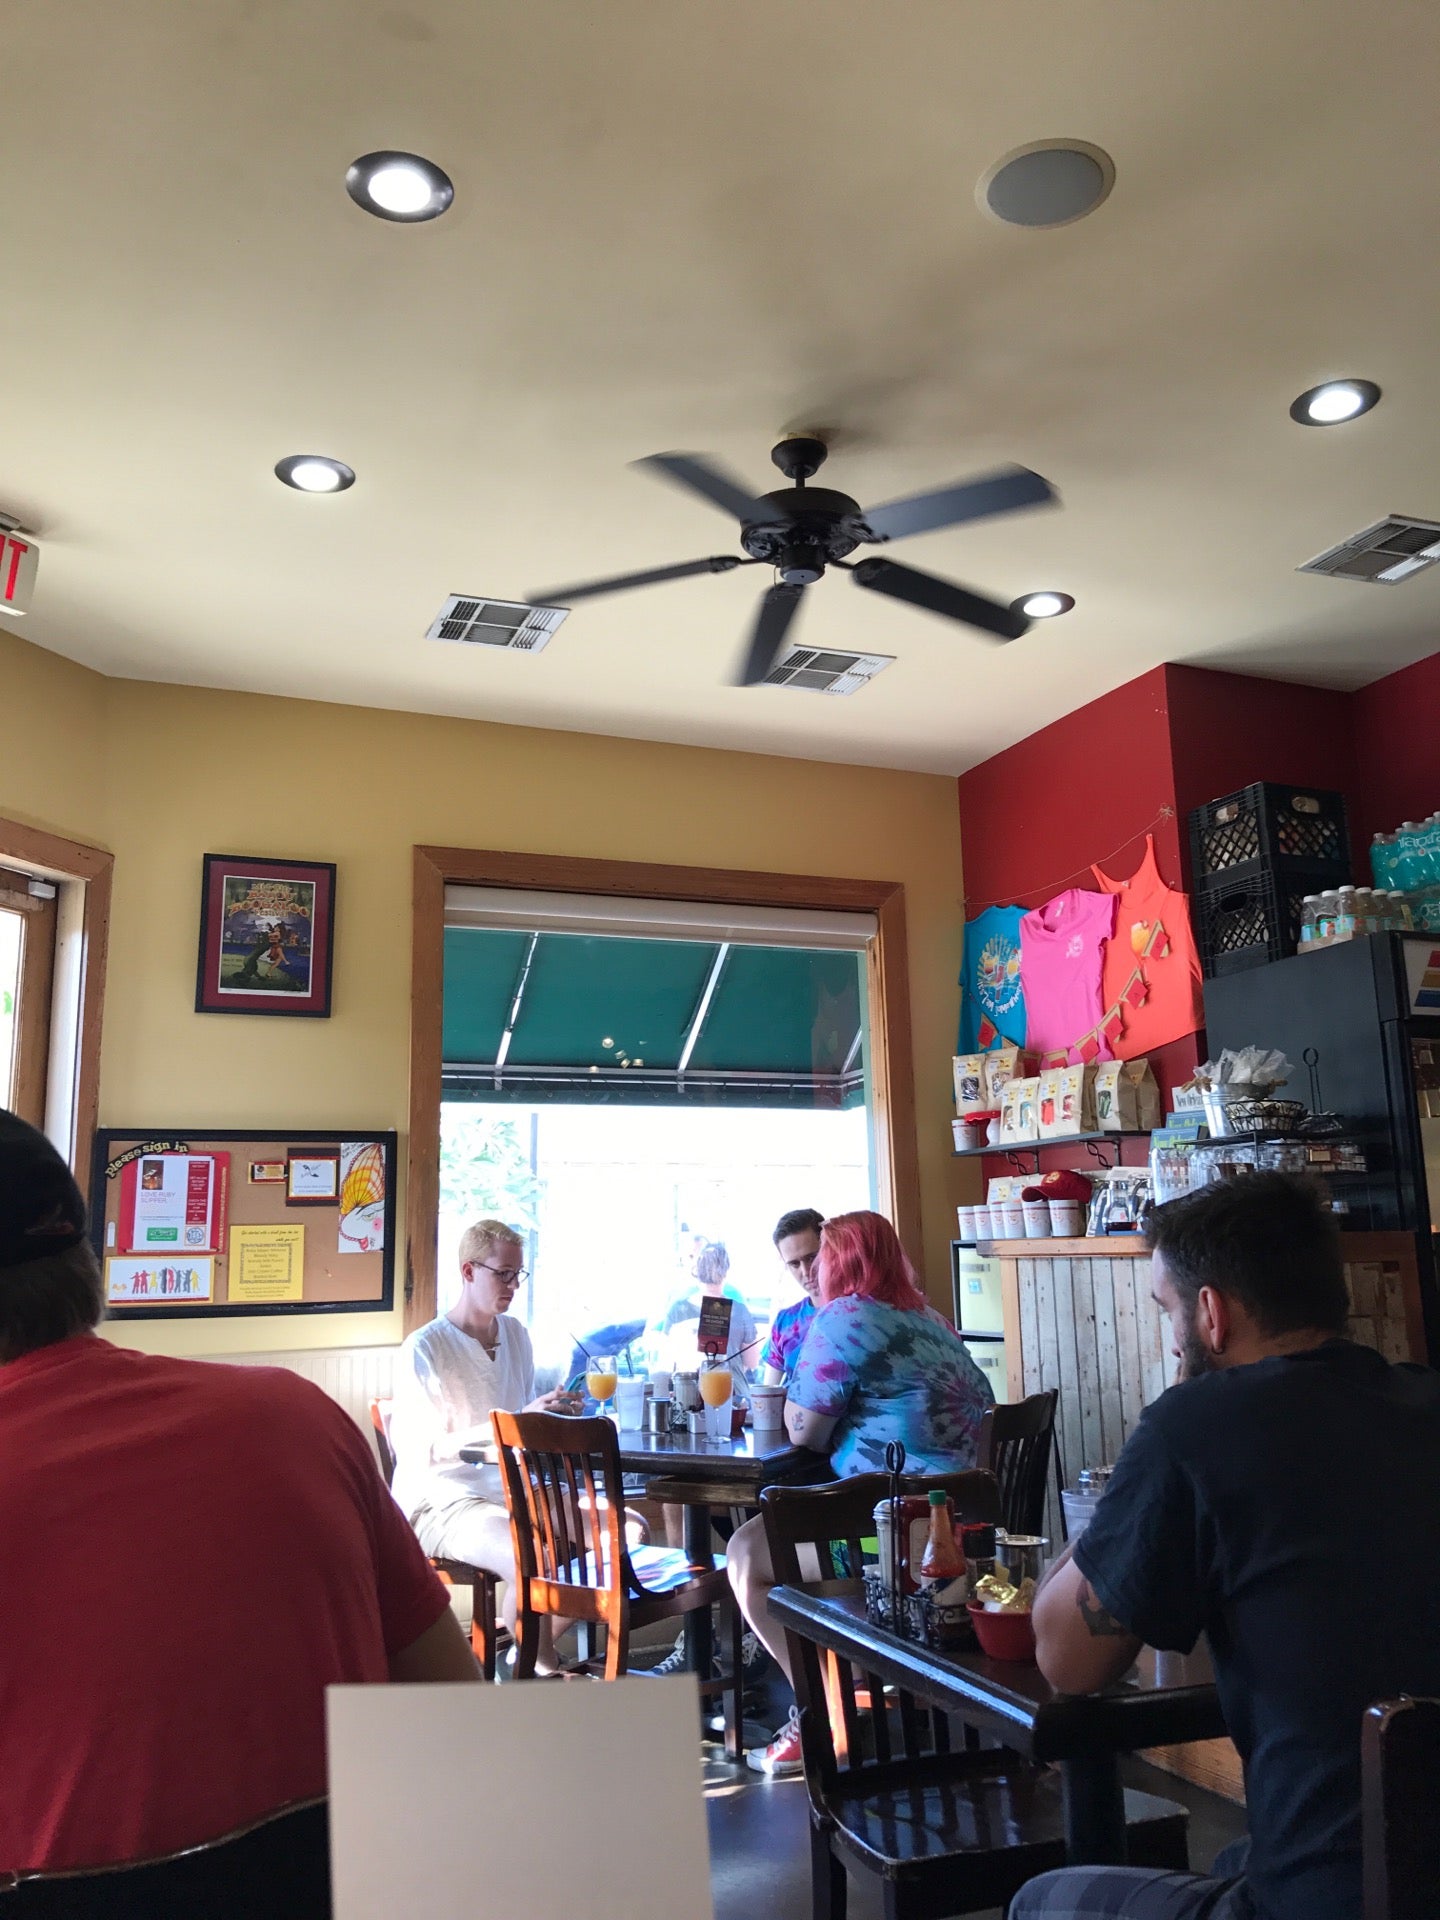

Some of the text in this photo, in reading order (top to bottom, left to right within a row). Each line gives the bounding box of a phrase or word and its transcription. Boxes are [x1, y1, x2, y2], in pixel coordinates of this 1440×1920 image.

[105, 1141, 188, 1178] please sign in
